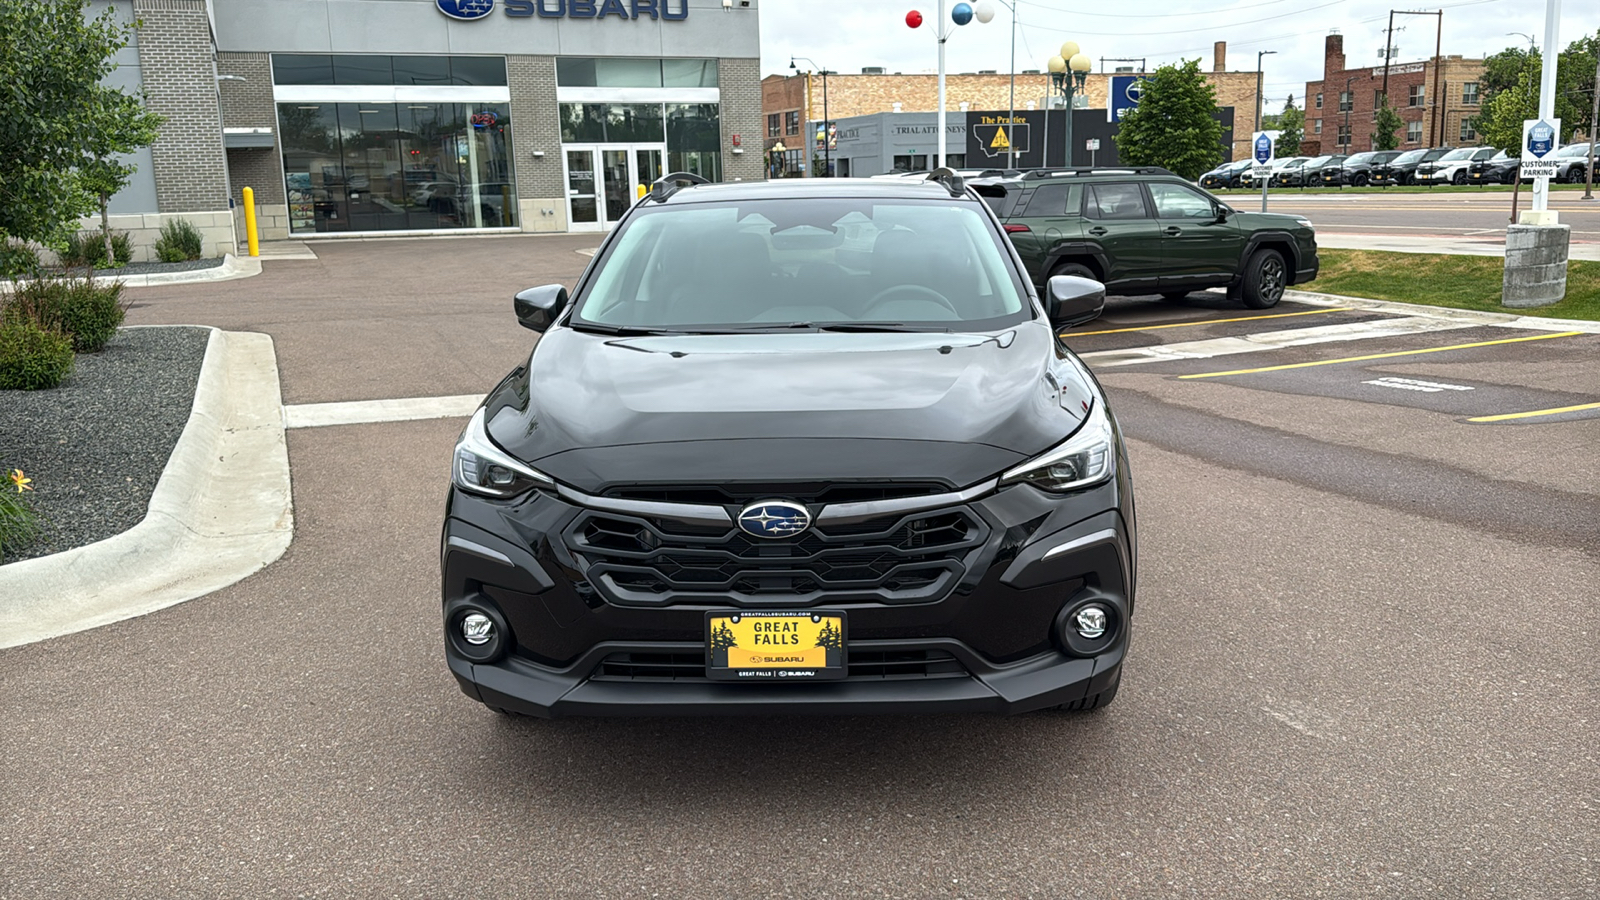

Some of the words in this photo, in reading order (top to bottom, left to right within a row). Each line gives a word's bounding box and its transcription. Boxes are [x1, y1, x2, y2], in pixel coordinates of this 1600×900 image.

[505, 0, 688, 20] SUBARU
[981, 116, 995, 124] The
[997, 116, 1026, 124] Pratice
[896, 126, 920, 134] TRIAL
[922, 126, 966, 134] ATTNEYS
[1521, 160, 1557, 168] CUSTOMER
[754, 622, 799, 632] GREAT
[754, 634, 799, 645] FALLS
